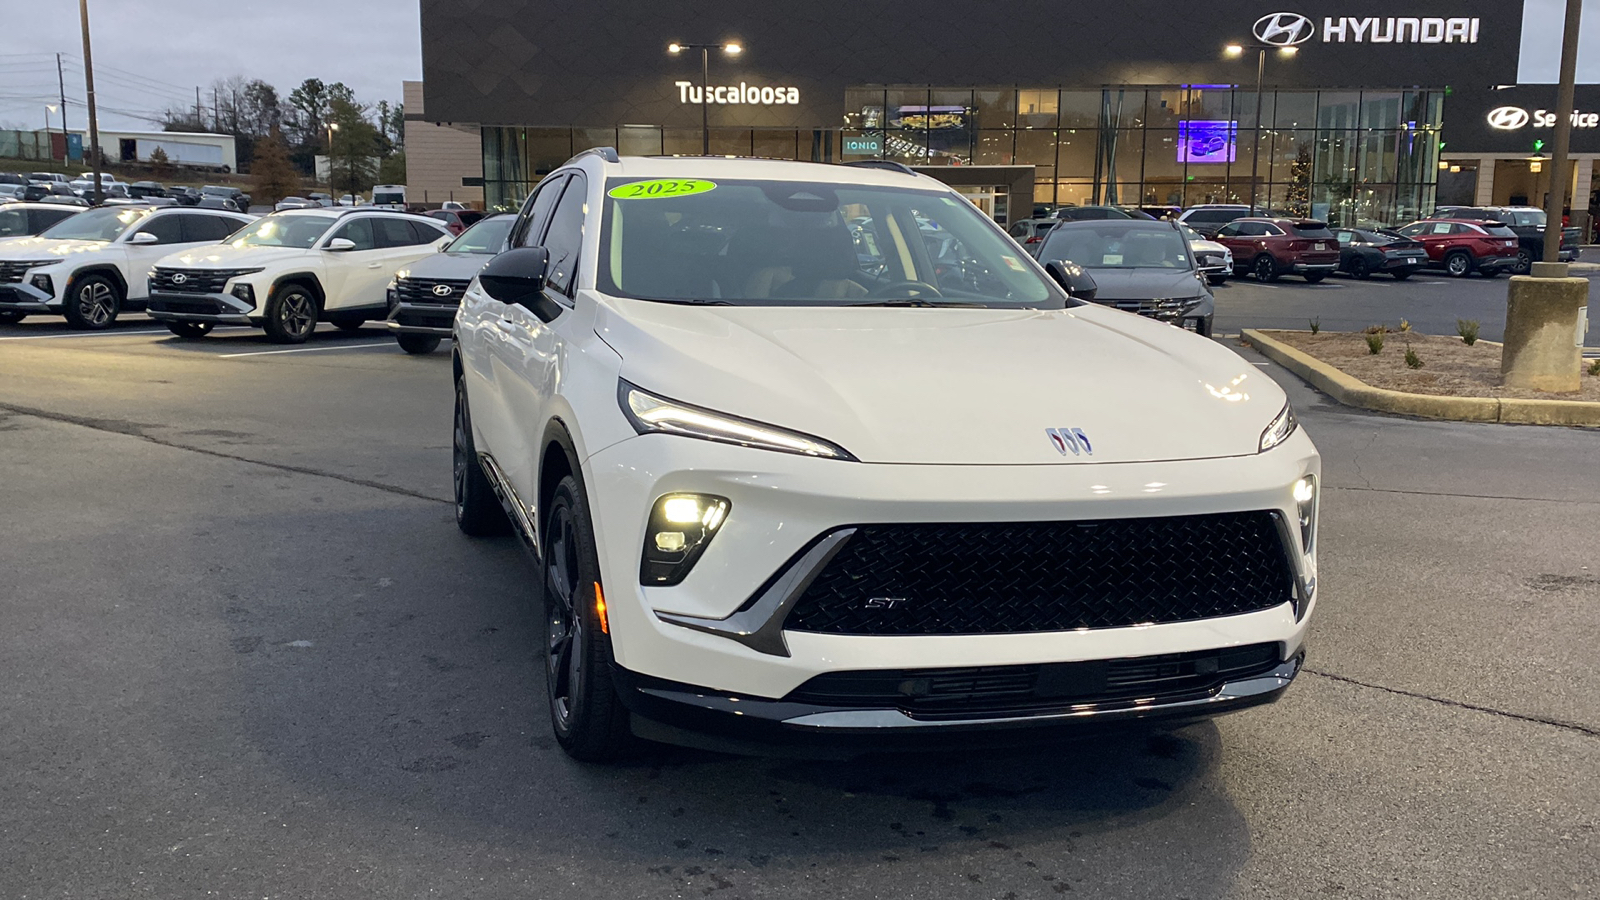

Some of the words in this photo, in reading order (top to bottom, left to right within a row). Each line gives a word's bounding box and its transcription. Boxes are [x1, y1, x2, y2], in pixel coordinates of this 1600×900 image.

[1323, 17, 1480, 43] HYUNDAI
[675, 81, 800, 104] Tuscaloosa
[1533, 109, 1599, 128] Seice
[846, 141, 878, 150] IONIQ
[629, 180, 697, 197] 2025
[864, 597, 906, 609] ST
